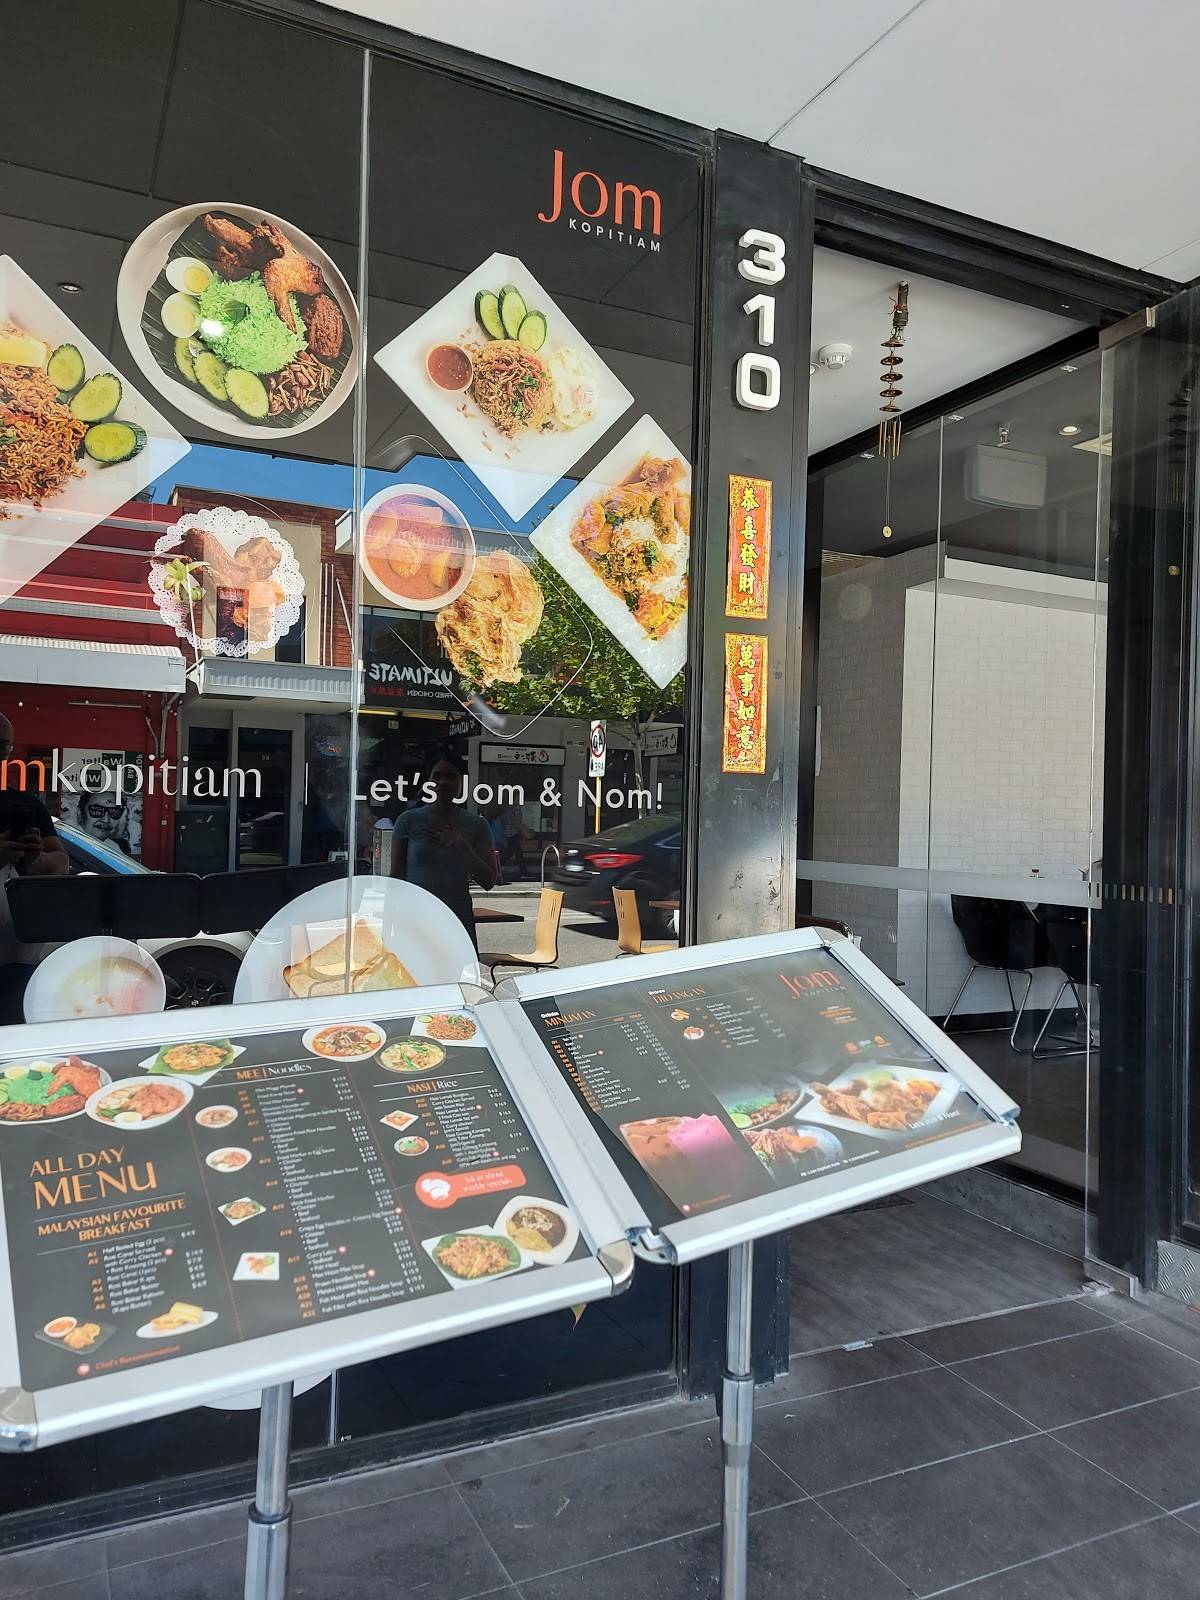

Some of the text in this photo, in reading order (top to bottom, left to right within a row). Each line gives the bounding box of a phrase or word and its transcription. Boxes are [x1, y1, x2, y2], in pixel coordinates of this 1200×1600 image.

[537, 149, 662, 236] Jom
[568, 217, 661, 253] KOPITIAM
[735, 228, 786, 411] 310
[738, 486, 760, 595] 恭喜發財
[735, 643, 757, 751] 萬事如意
[452, 774, 525, 806] Jom
[539, 777, 562, 807] &
[577, 778, 664, 810] Nom!
[780, 969, 841, 999] Jom
[236, 1062, 312, 1080] MEE Noodles
[406, 1079, 458, 1094] NASI Rice
[30, 1146, 126, 1178] ALL DAY
[33, 1160, 158, 1210] MENU
[38, 1198, 187, 1237] MALAYSIAN FAVOURITE
[78, 1216, 152, 1242] BREAKFAST
